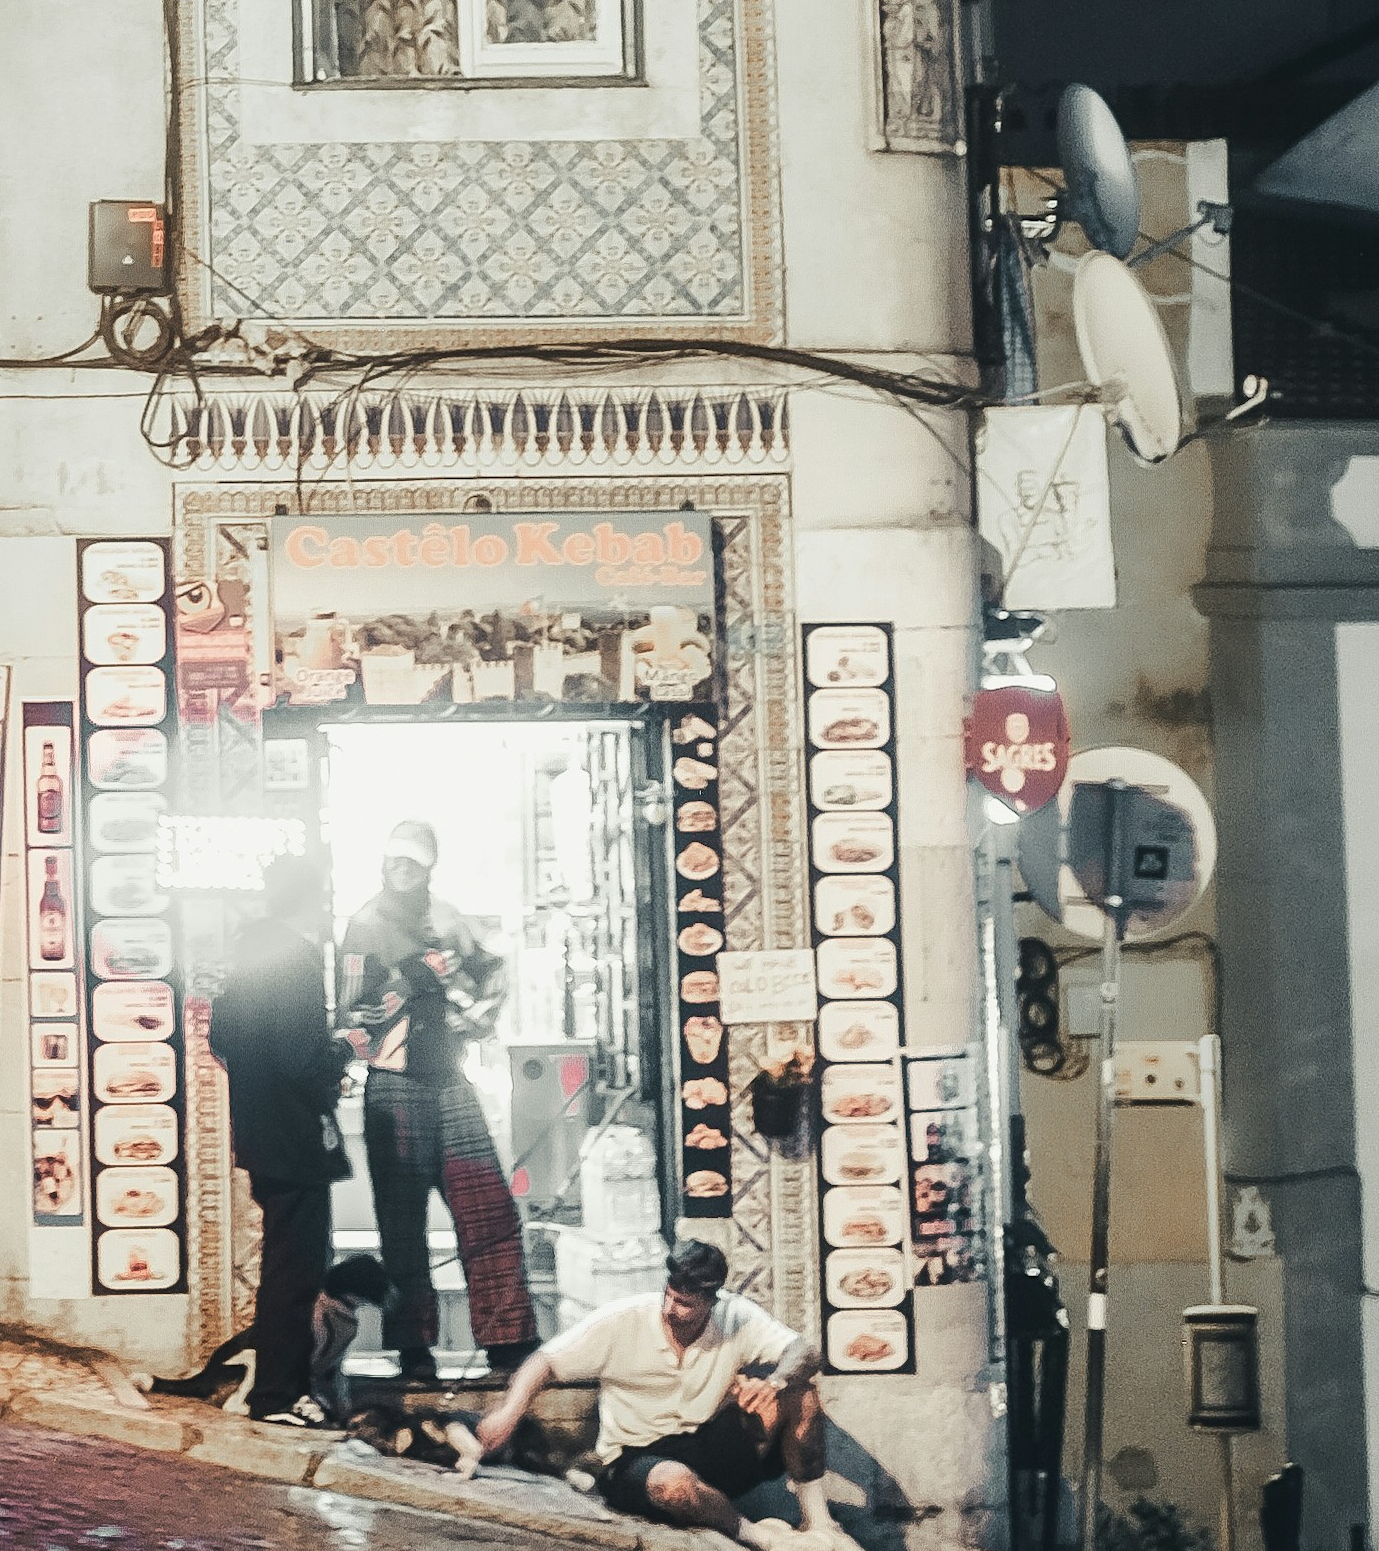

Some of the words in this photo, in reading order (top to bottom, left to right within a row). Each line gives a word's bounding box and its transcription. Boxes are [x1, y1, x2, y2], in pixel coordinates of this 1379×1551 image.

[285, 521, 509, 568] Castêlo
[513, 521, 703, 566] Kebab
[980, 742, 1056, 773] SAGRES
